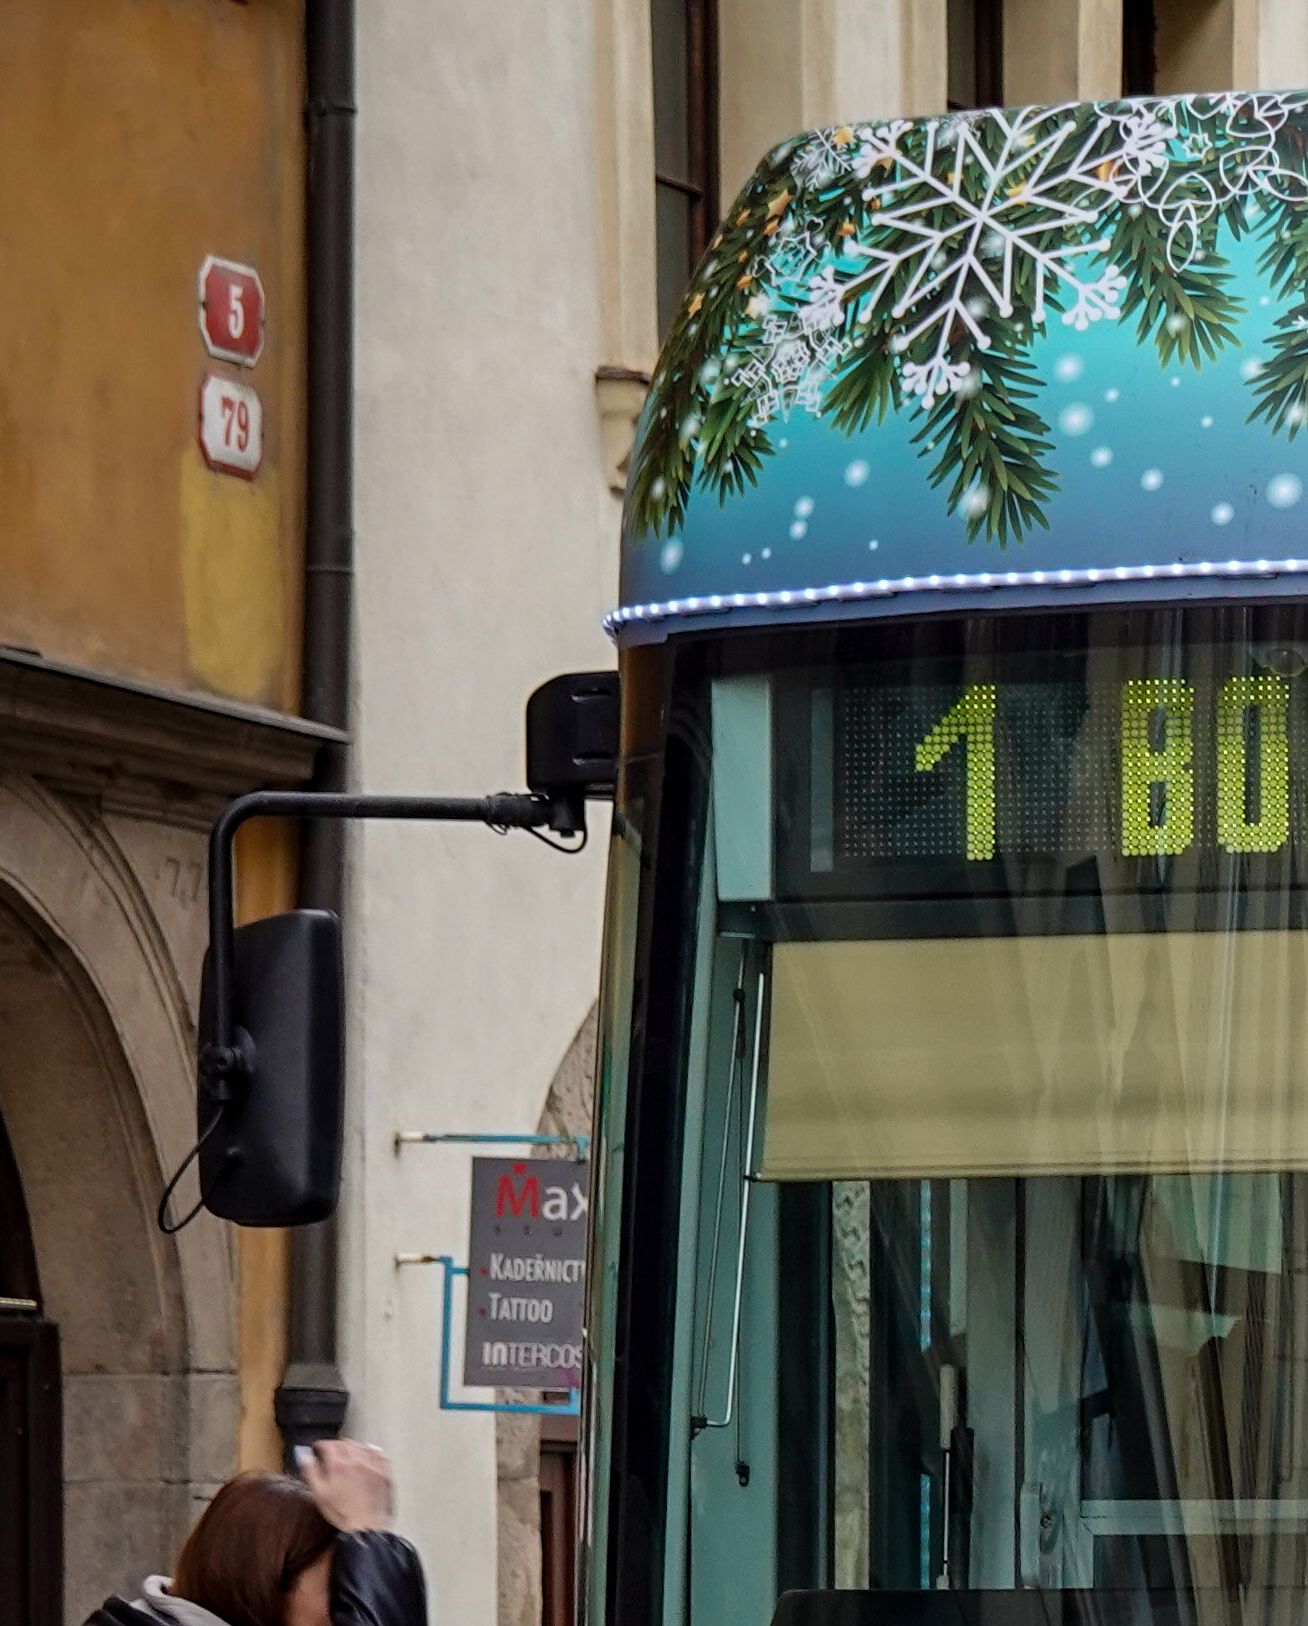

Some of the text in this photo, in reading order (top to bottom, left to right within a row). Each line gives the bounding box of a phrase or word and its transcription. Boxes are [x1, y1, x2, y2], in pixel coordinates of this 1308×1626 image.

[227, 284, 245, 340] 5
[220, 396, 249, 452] 79
[914, 682, 996, 862] 1
